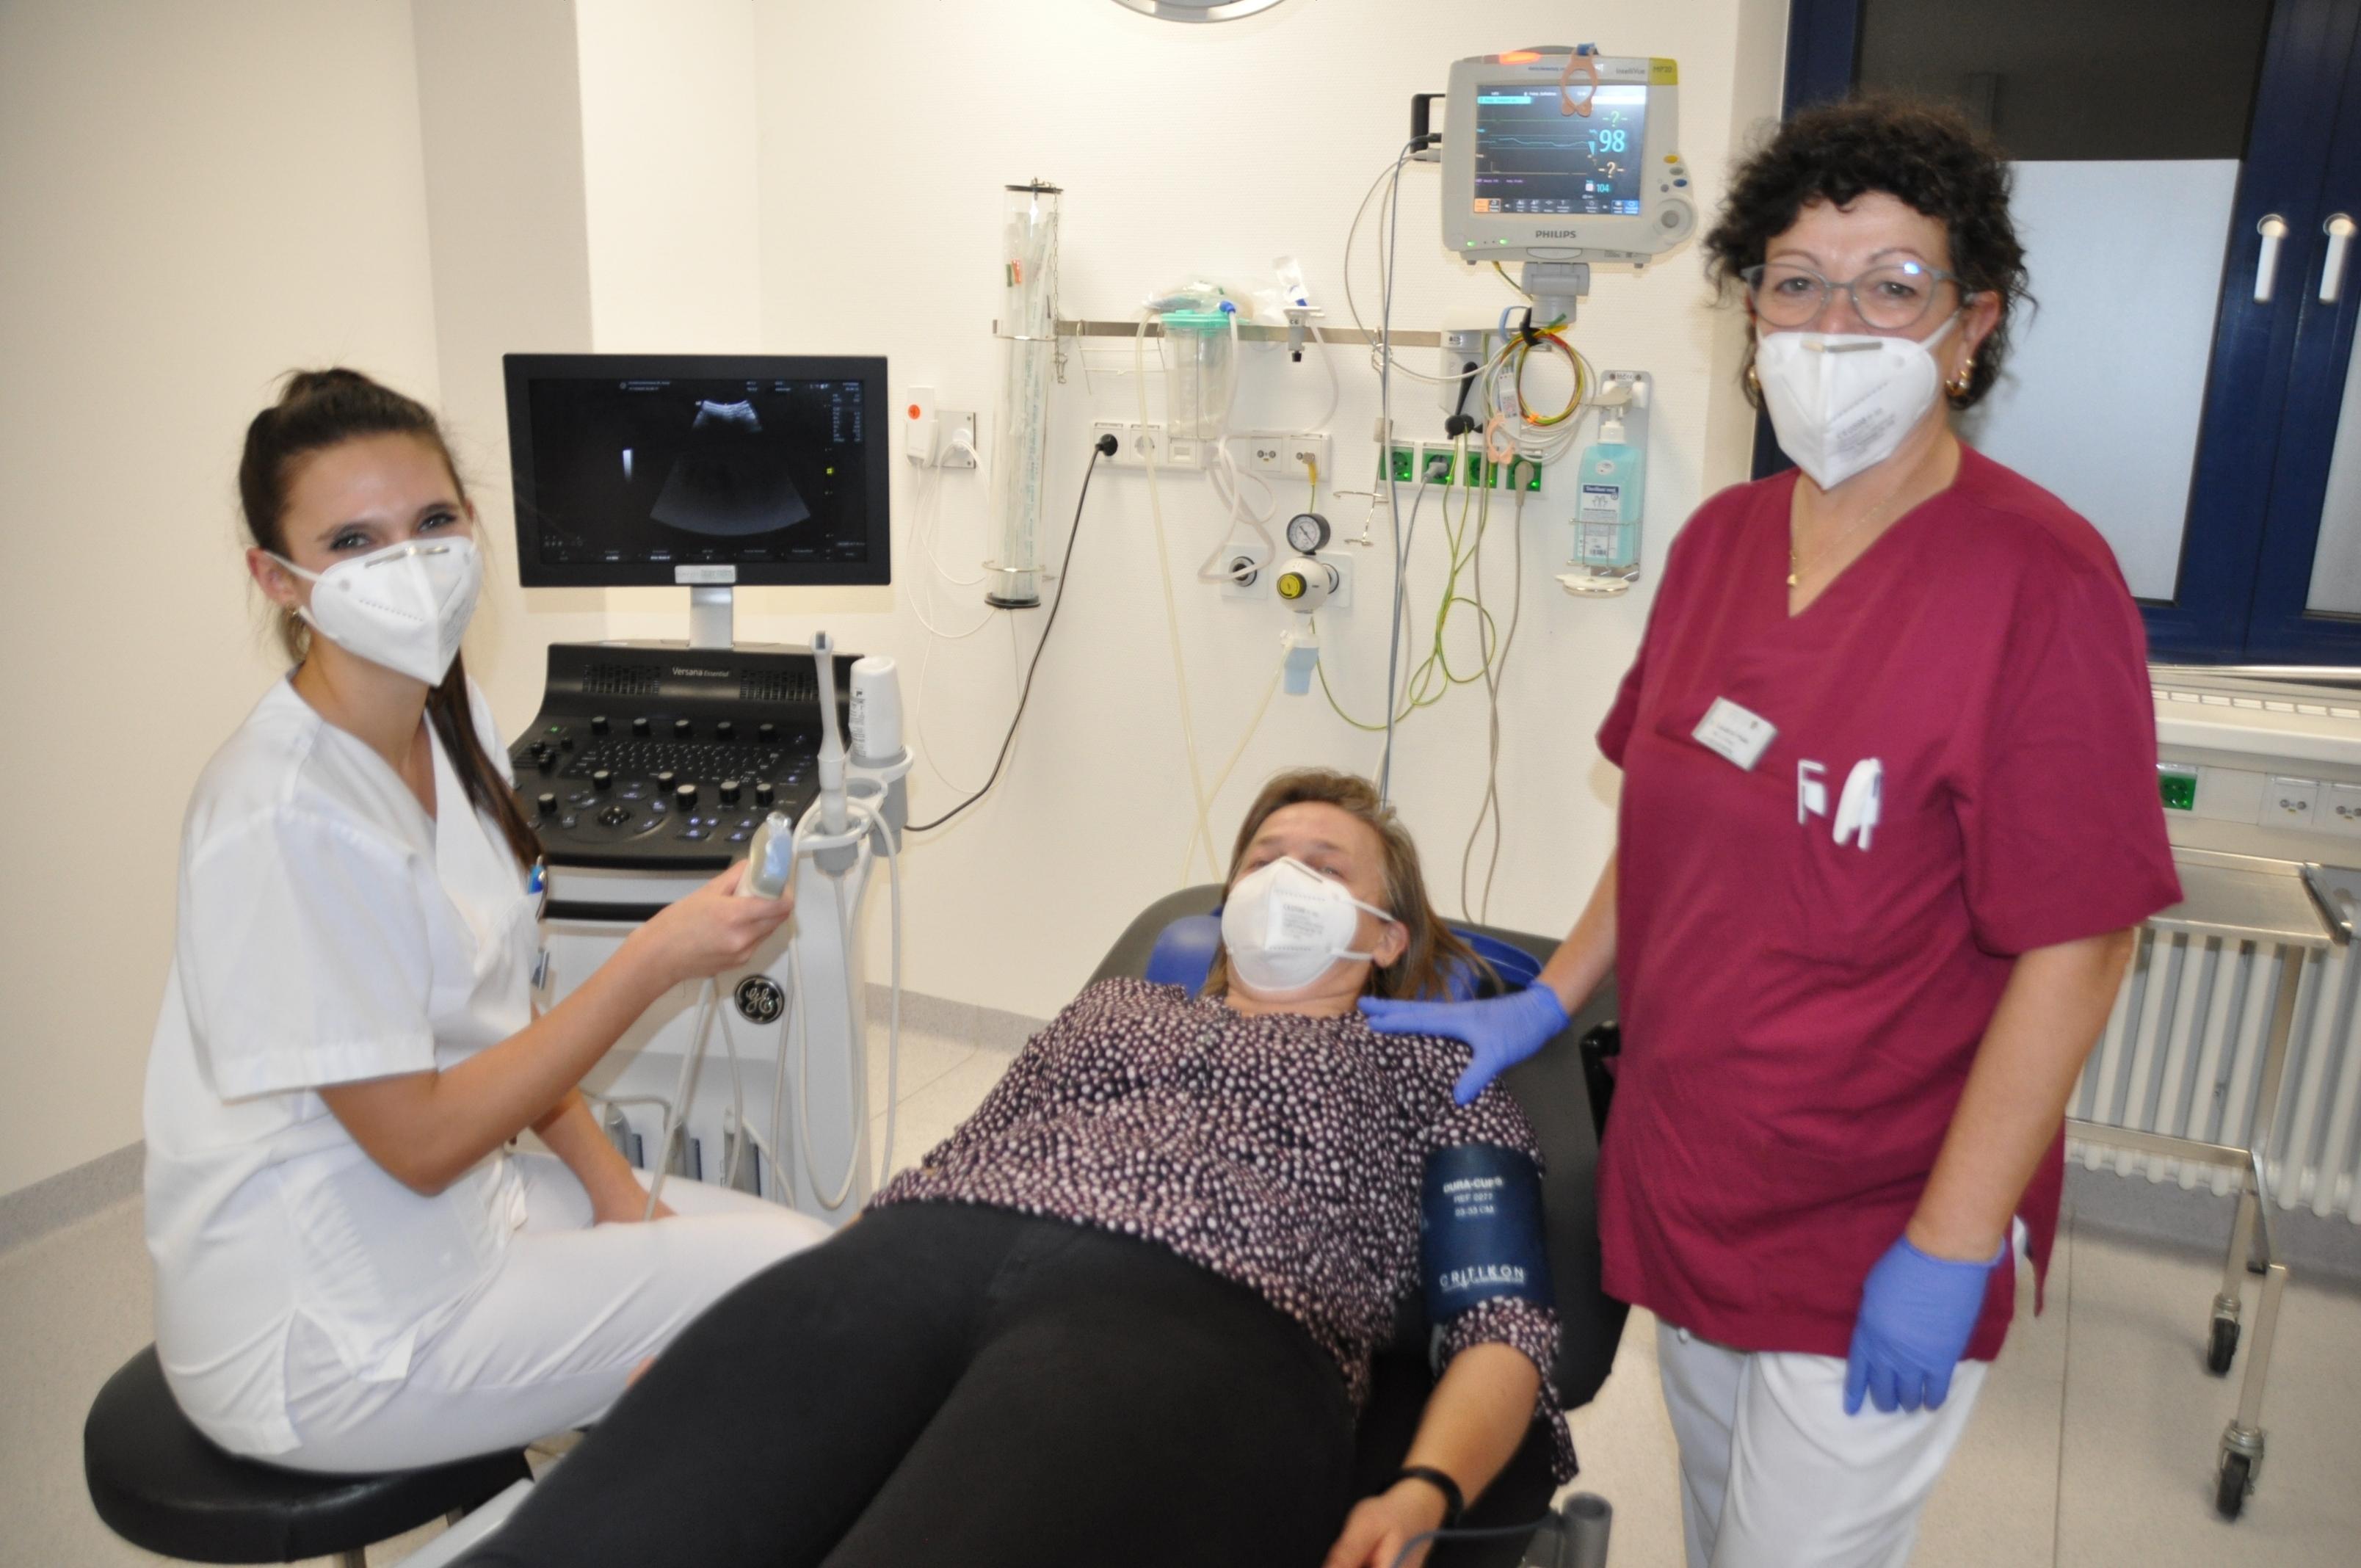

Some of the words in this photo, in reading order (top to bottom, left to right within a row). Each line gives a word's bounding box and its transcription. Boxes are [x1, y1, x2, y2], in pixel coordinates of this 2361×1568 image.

[1599, 128, 1625, 152] 98
[1596, 184, 1610, 192] 104
[1535, 230, 1577, 239] PHILIPS
[672, 667, 703, 676] Versana
[1439, 1263, 1526, 1288] CRITIKON
